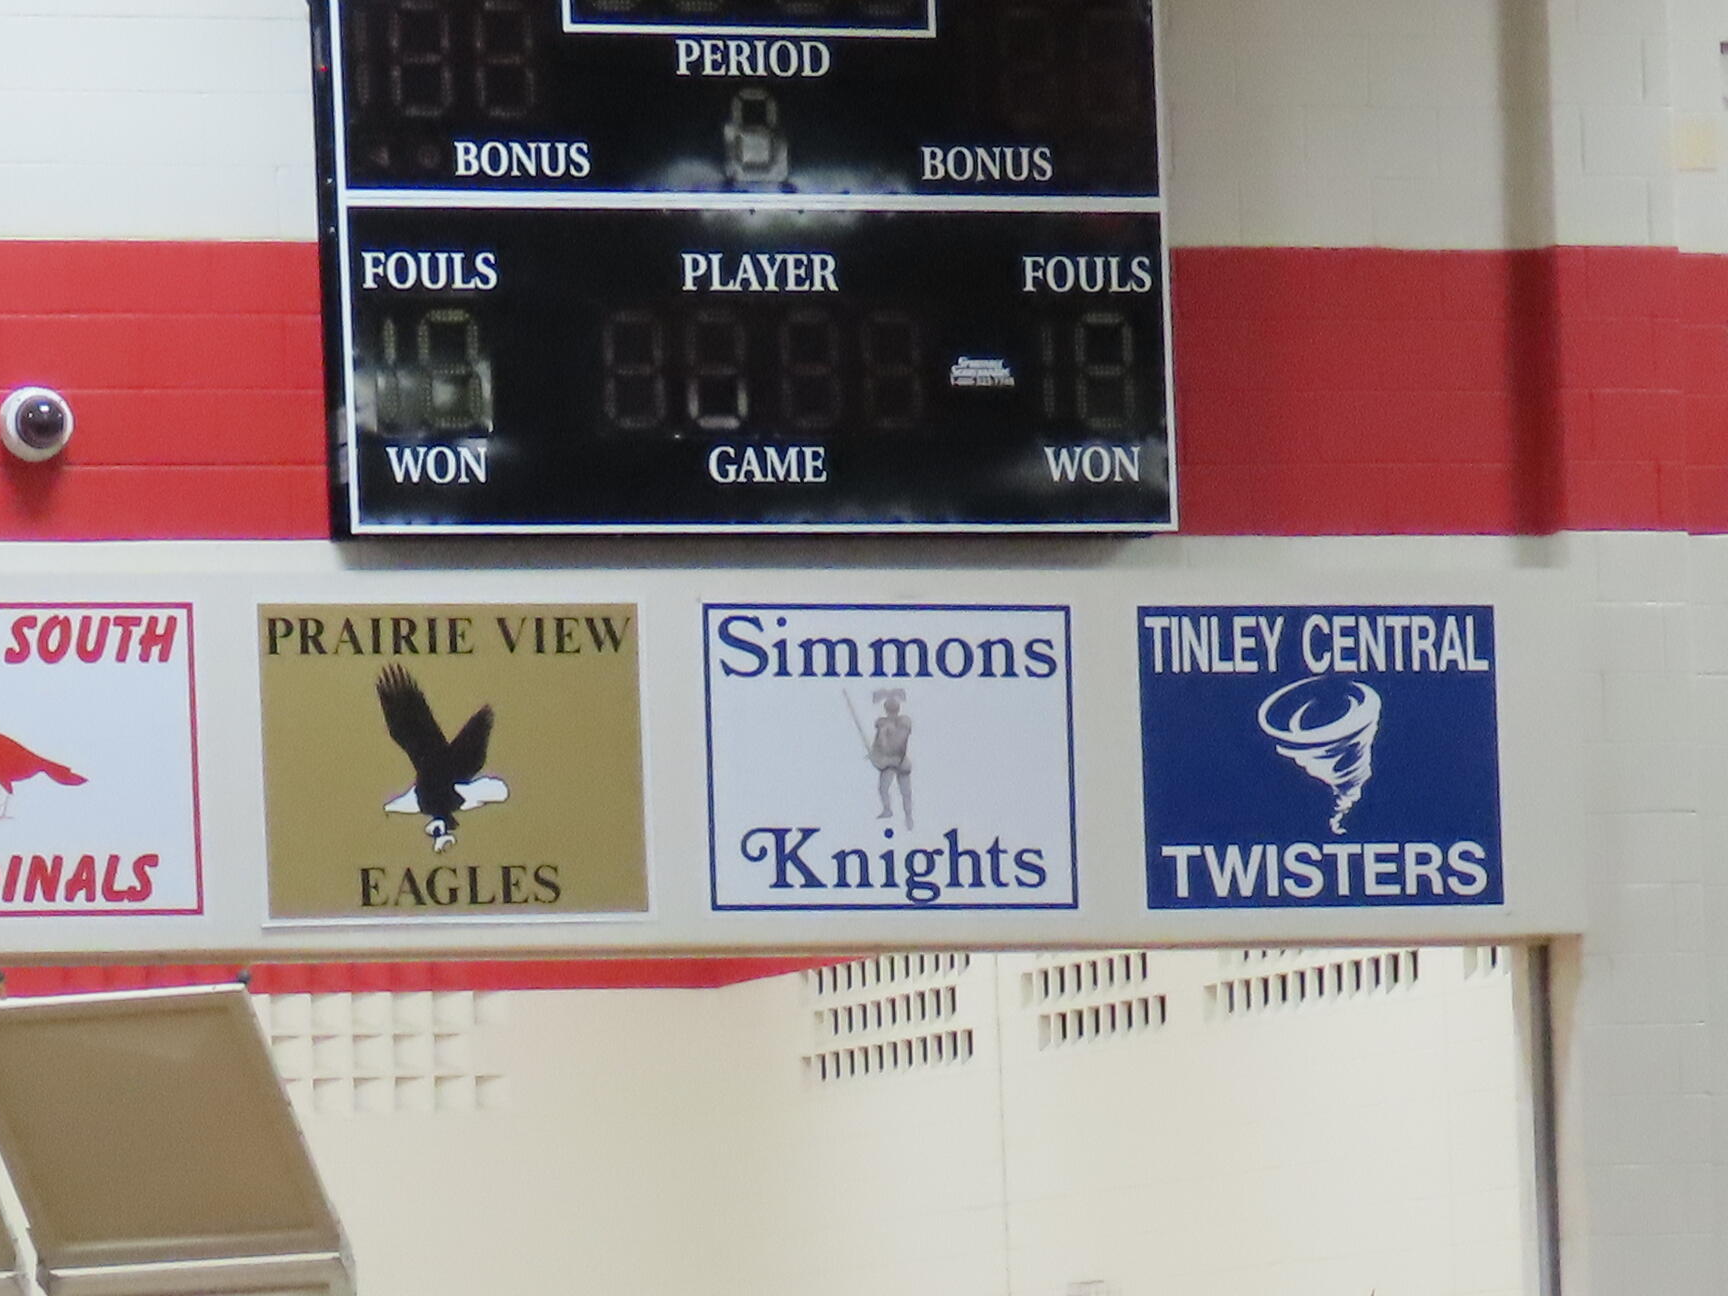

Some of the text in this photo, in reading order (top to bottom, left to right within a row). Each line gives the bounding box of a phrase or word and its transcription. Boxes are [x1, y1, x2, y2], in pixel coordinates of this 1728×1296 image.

[674, 41, 831, 77] PERIOD
[452, 142, 592, 178] BONUS
[920, 146, 1054, 182] BONUS
[361, 251, 499, 291] FOULS
[681, 253, 839, 294] PLAYER
[1021, 256, 1153, 294] FOULS
[386, 447, 488, 484] WON
[708, 446, 828, 484] GAME
[1043, 446, 1142, 484] WON
[3, 614, 178, 665] SOUTH
[265, 614, 632, 658] PRAIRIE VIEW
[717, 616, 1059, 680] Simmons
[1144, 615, 1489, 674] TINLEY CENTRAL
[740, 826, 1049, 904] Knights
[1159, 841, 1489, 899] TWISTERS
[358, 864, 563, 909] EAGLES
